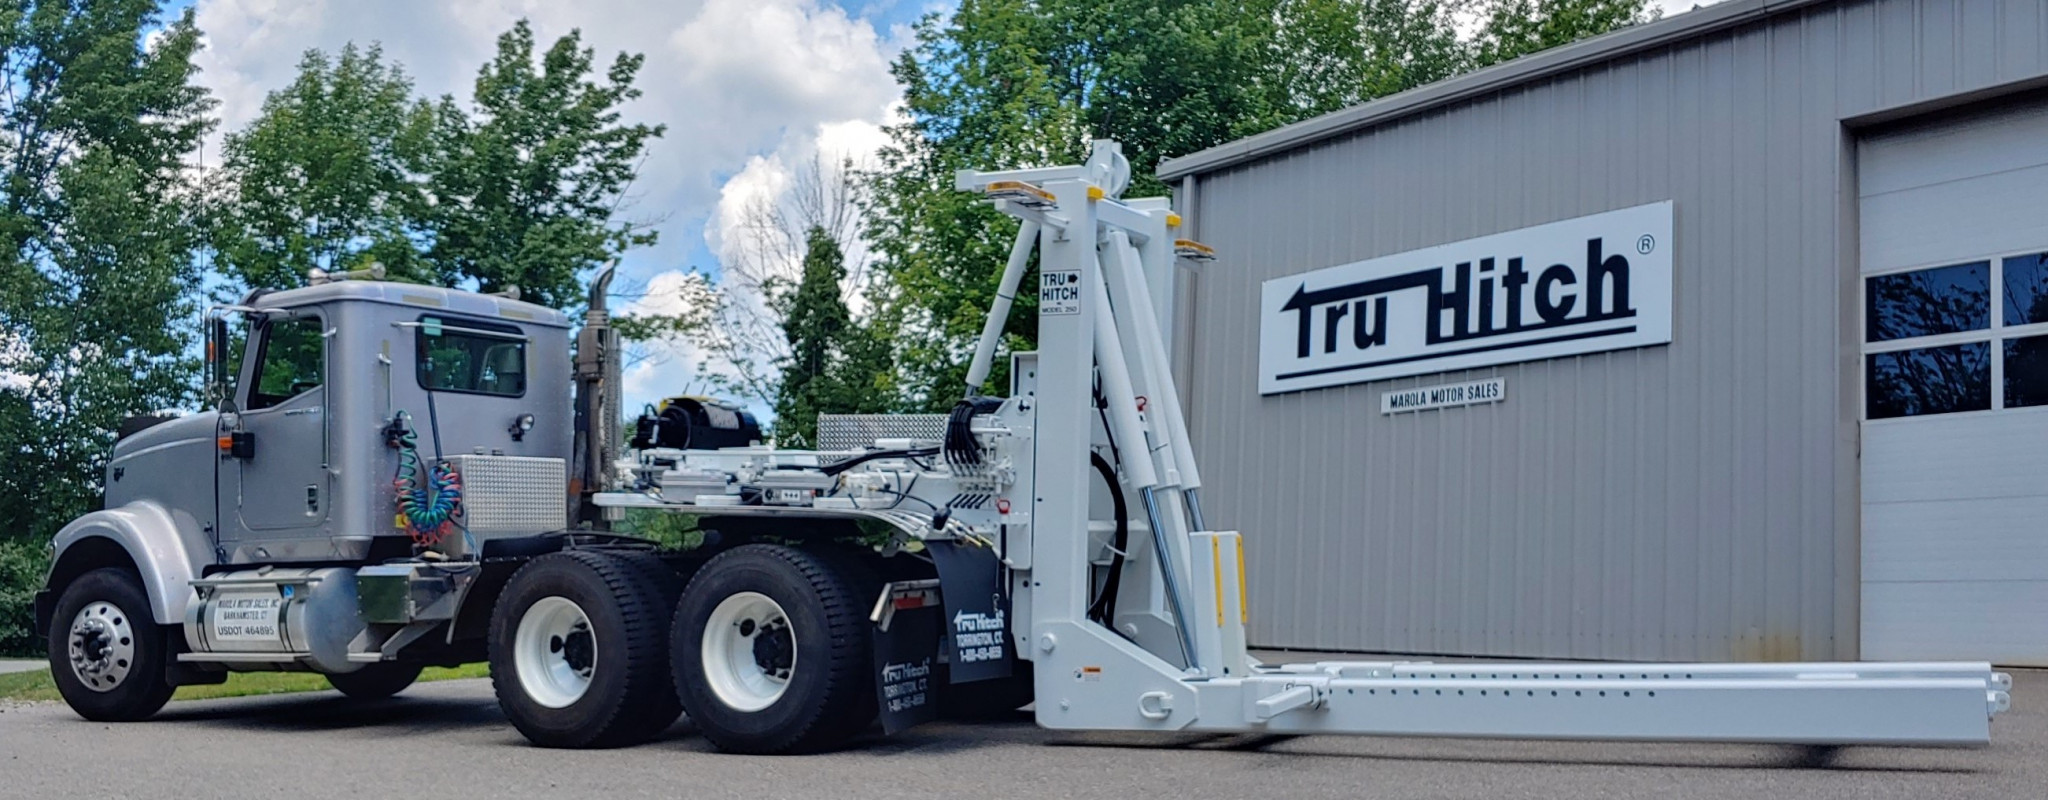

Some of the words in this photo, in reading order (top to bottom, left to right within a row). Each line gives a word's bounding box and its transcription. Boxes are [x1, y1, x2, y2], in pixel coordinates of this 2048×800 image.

[1042, 273, 1065, 287] TRU
[1042, 287, 1078, 301] HITCH
[1279, 281, 1388, 359] Tru
[1425, 237, 1637, 346] Hitch
[1390, 390, 1426, 409] MAROLA
[1431, 387, 1463, 404] MOTOR
[1468, 382, 1498, 400] SALES
[953, 609, 976, 632] Tru
[977, 611, 1004, 630] Hitch
[218, 626, 242, 635] USDOT
[245, 626, 275, 635] 464895
